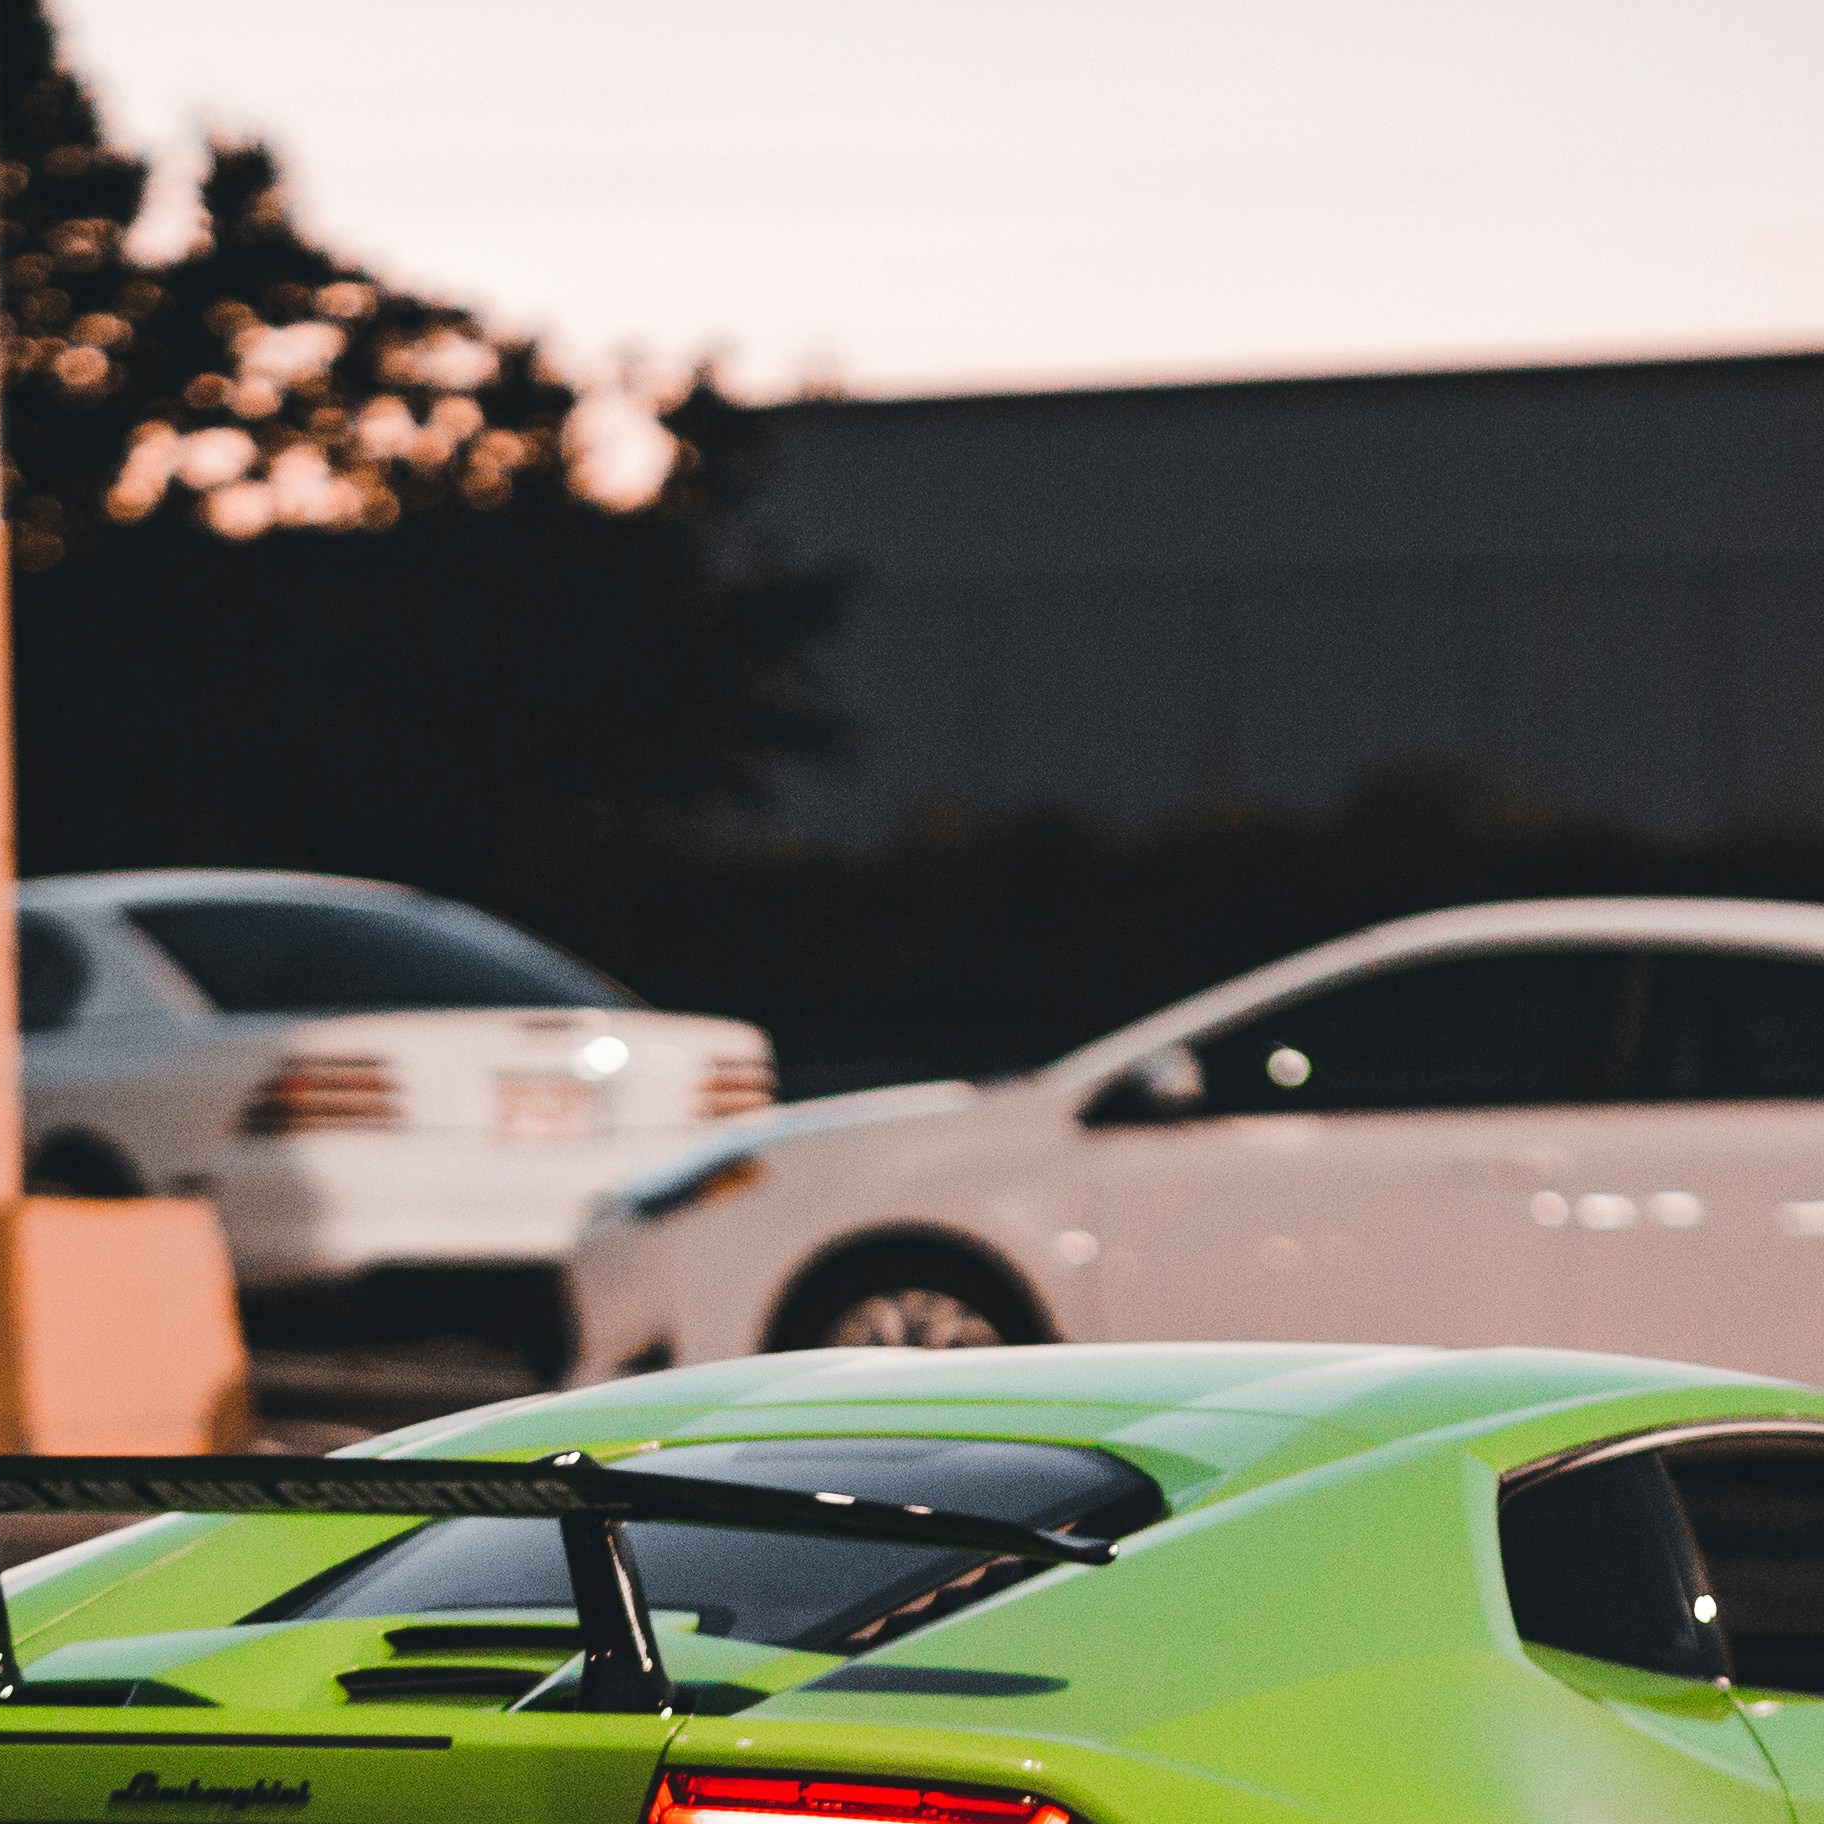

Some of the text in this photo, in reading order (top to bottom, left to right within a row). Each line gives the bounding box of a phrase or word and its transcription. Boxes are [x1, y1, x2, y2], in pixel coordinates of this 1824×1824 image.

[38, 1477, 154, 1508] KM
[146, 1477, 272, 1510] AND
[109, 1770, 312, 1811] Lamborghini
